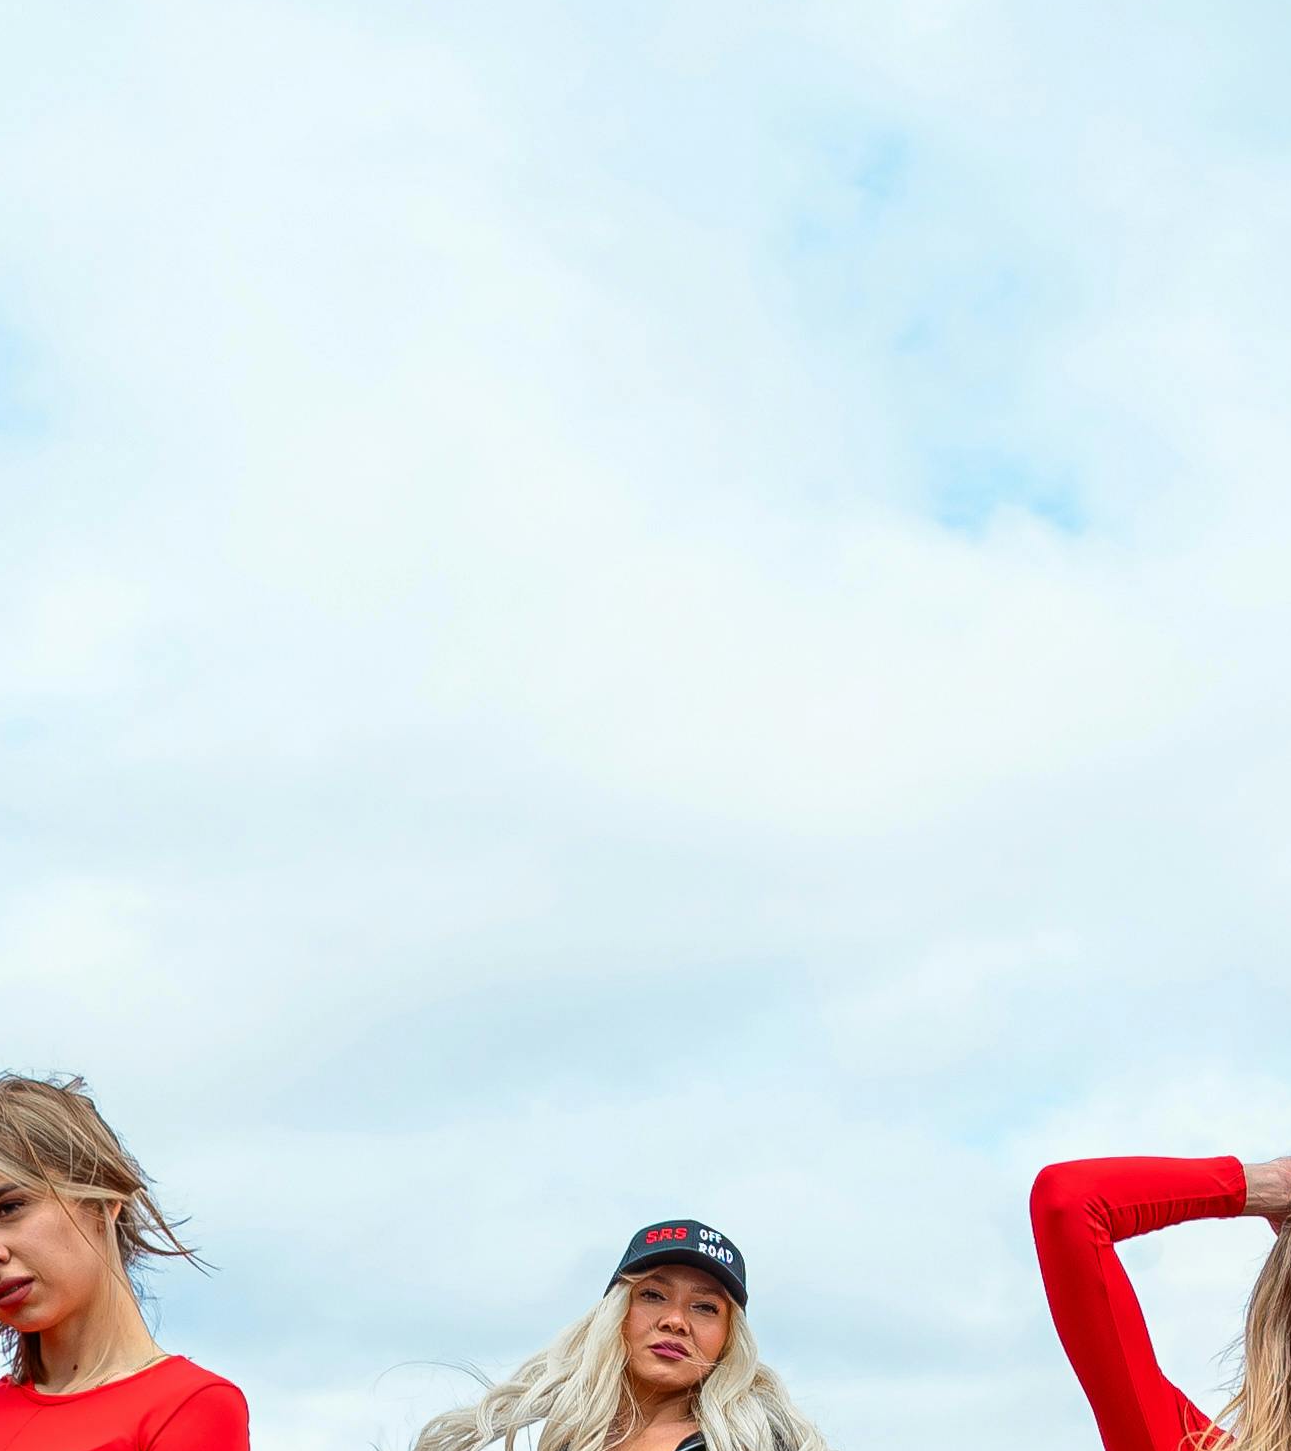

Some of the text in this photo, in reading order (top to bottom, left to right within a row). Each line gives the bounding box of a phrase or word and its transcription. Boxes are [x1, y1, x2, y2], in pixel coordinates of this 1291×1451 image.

[645, 1227, 688, 1244] SRS
[699, 1228, 723, 1243] OFF
[698, 1242, 734, 1264] ROAD
